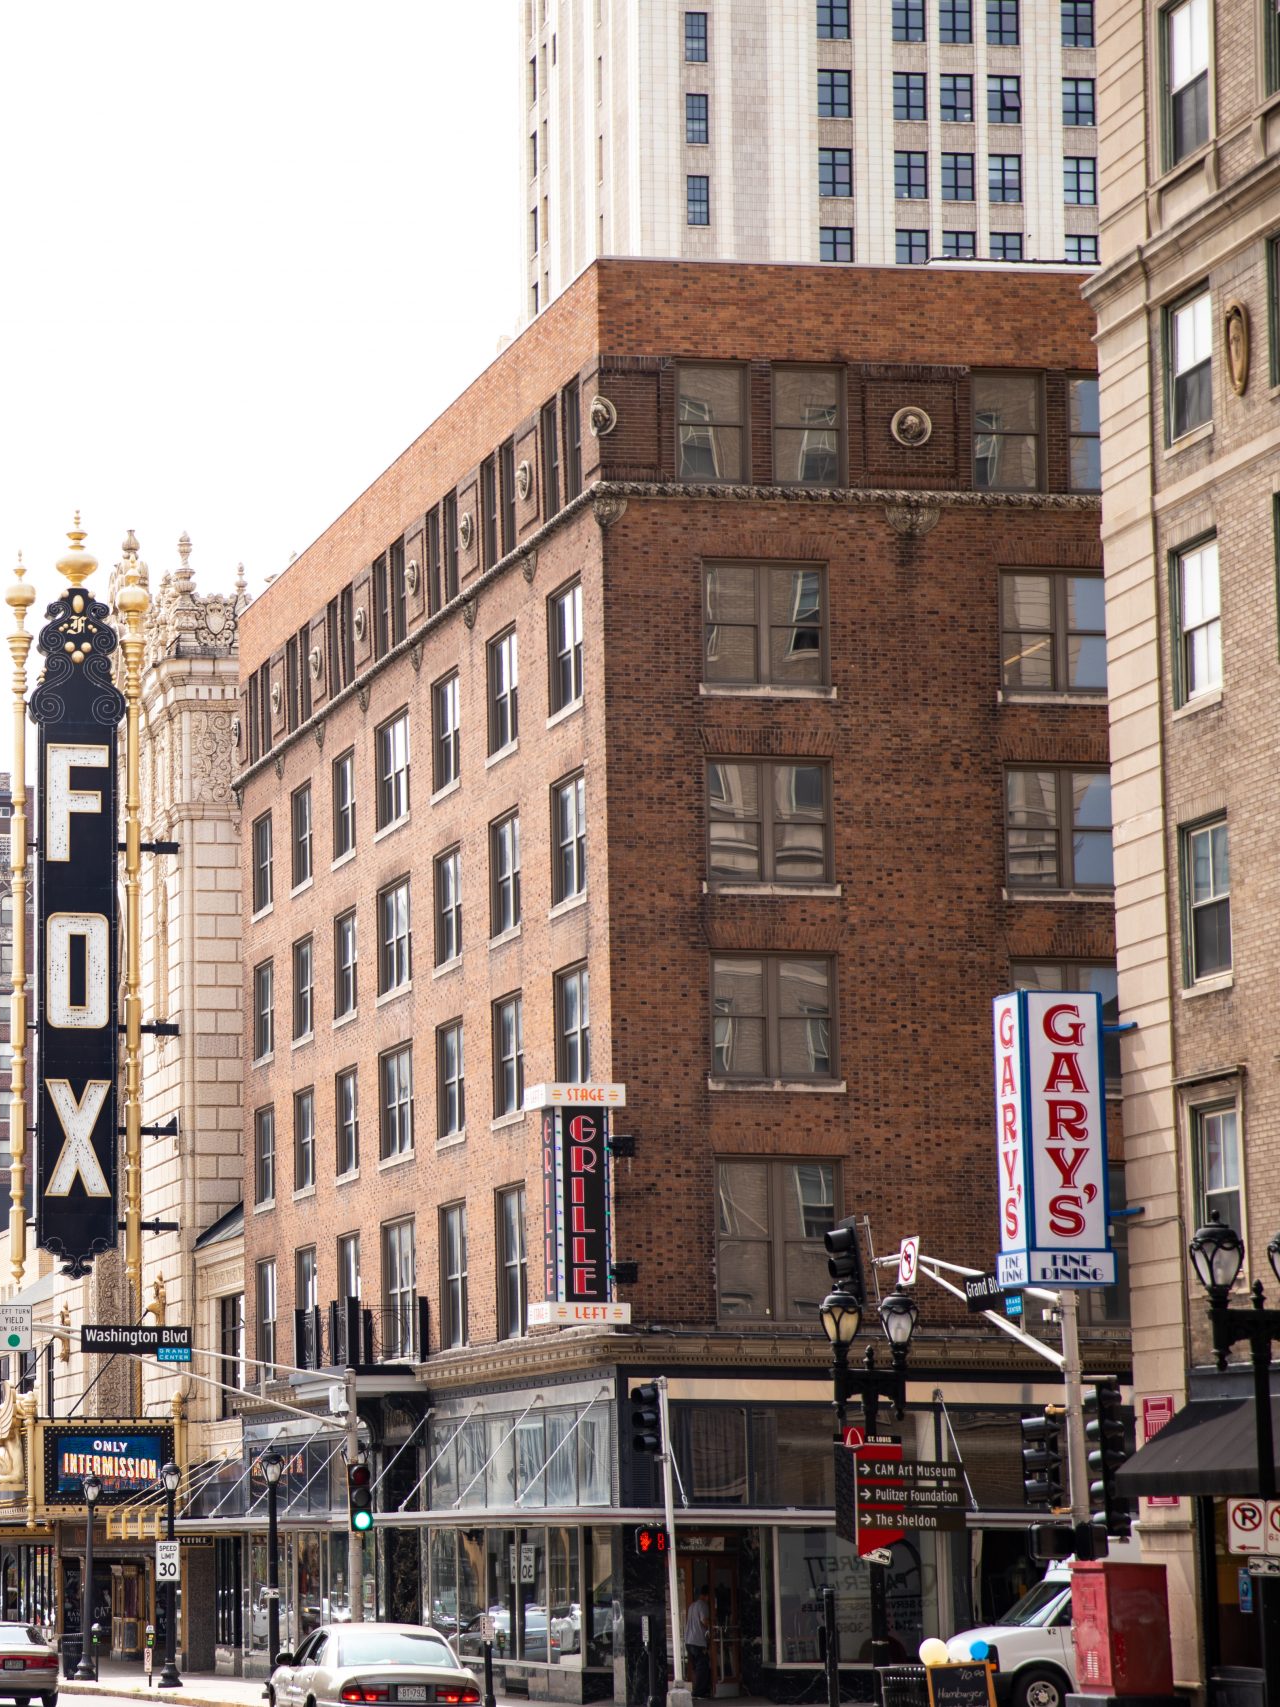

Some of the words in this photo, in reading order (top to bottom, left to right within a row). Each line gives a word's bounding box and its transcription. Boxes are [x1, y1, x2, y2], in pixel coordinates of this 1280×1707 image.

[45, 743, 111, 1197] FOX
[567, 1088, 605, 1101] STAGE
[999, 1007, 1022, 1240] GARY'S
[1043, 1003, 1098, 1238] GARY'S
[543, 1117, 554, 1295] GRILLE
[569, 1115, 597, 1294] GRILLE
[1005, 1256, 1020, 1269] FINE
[1051, 1254, 1092, 1266] FINE
[1040, 1268, 1104, 1281] DINING
[966, 1278, 988, 1297] Grand
[575, 1306, 608, 1319] LEFT
[85, 1329, 158, 1345] Washington
[162, 1330, 188, 1343] Blvd
[93, 1440, 128, 1453] ONLY
[63, 1453, 157, 1479] INTERMISSION
[875, 1463, 894, 1475] CAM
[898, 1464, 913, 1476] Art
[916, 1465, 956, 1477] Museum
[875, 1489, 908, 1501] Pulitzer
[910, 1490, 958, 1502] Foundation
[876, 1514, 893, 1525] The
[896, 1514, 937, 1527] Sheldon
[159, 1562, 177, 1577] 30
